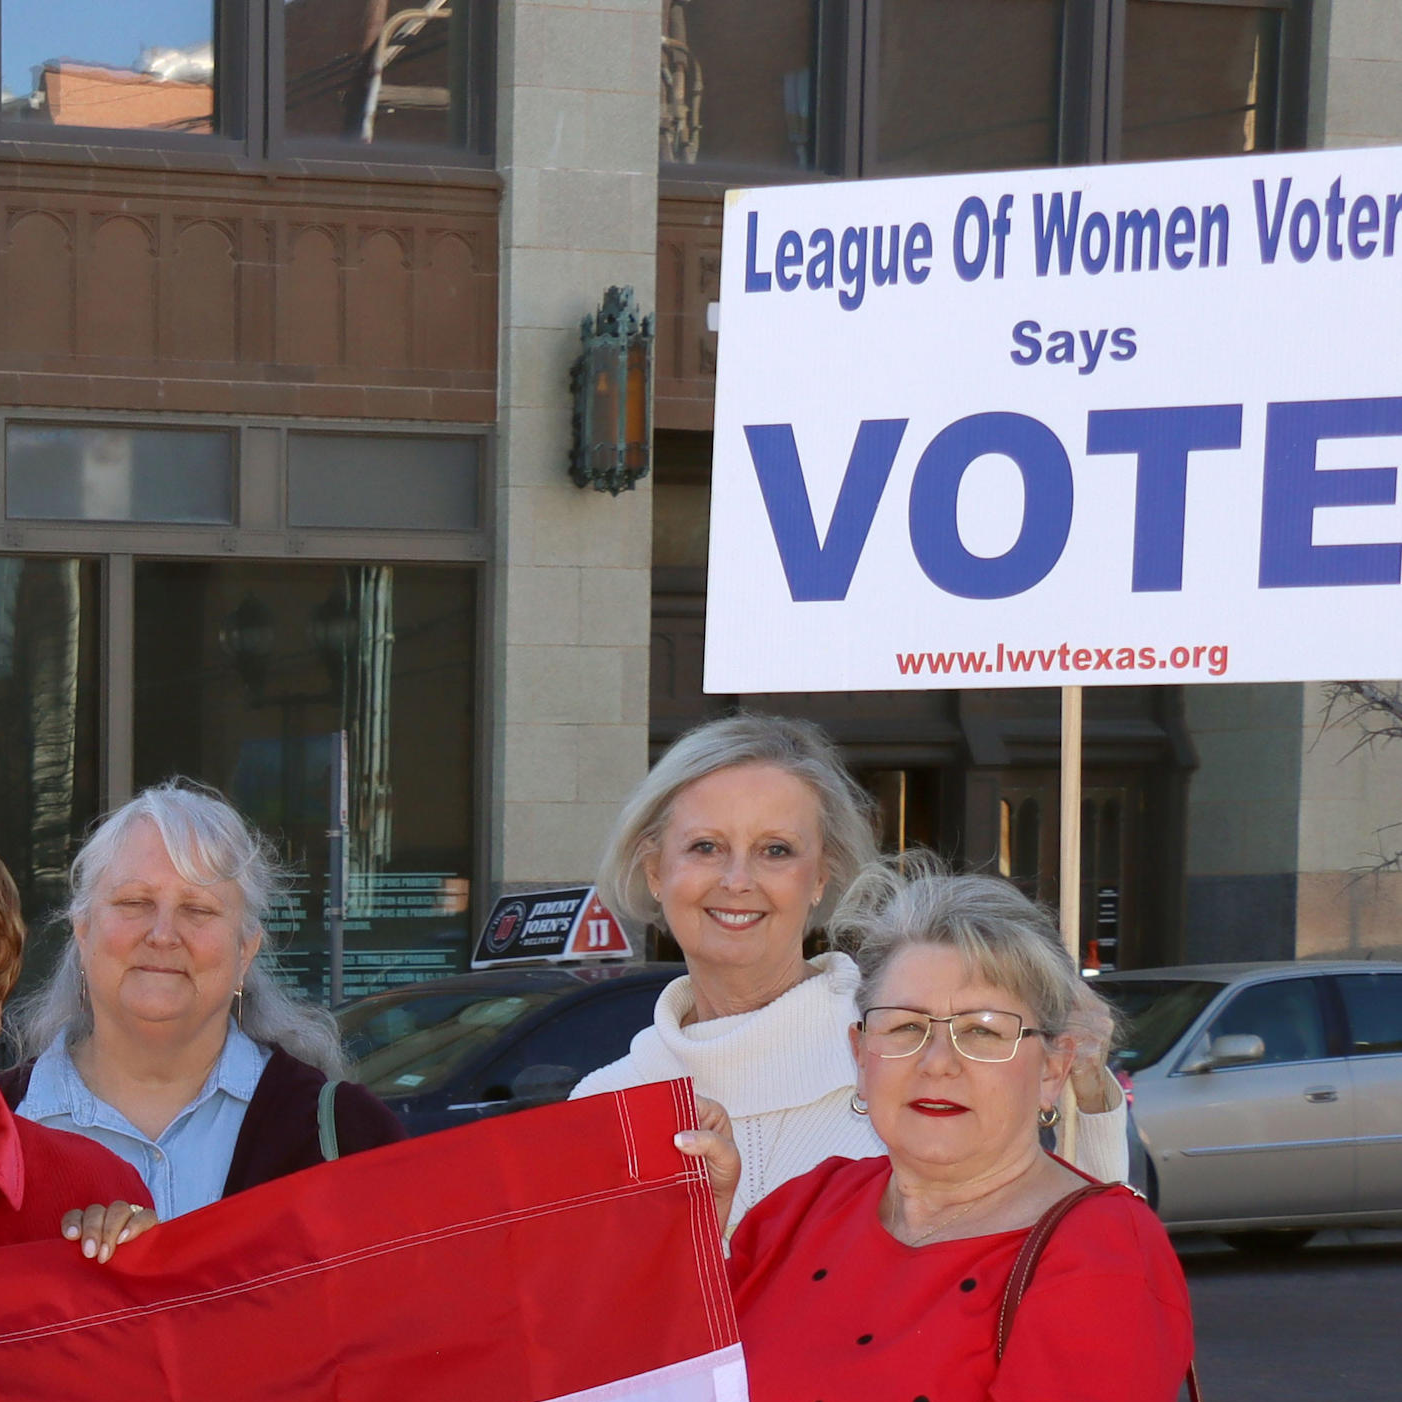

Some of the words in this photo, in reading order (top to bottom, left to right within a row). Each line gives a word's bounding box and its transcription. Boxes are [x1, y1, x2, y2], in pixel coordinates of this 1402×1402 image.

[745, 211, 933, 312] League
[953, 193, 1014, 282] Of
[1032, 190, 1230, 277] Women
[1253, 174, 1402, 264] Voter
[1010, 320, 1138, 376] Says
[743, 396, 1402, 602] VOTE
[896, 643, 1229, 676] www.lwvtexas.org
[528, 899, 581, 920] JIMMY
[520, 917, 573, 939] JOHN'S
[587, 919, 610, 947] JJ
